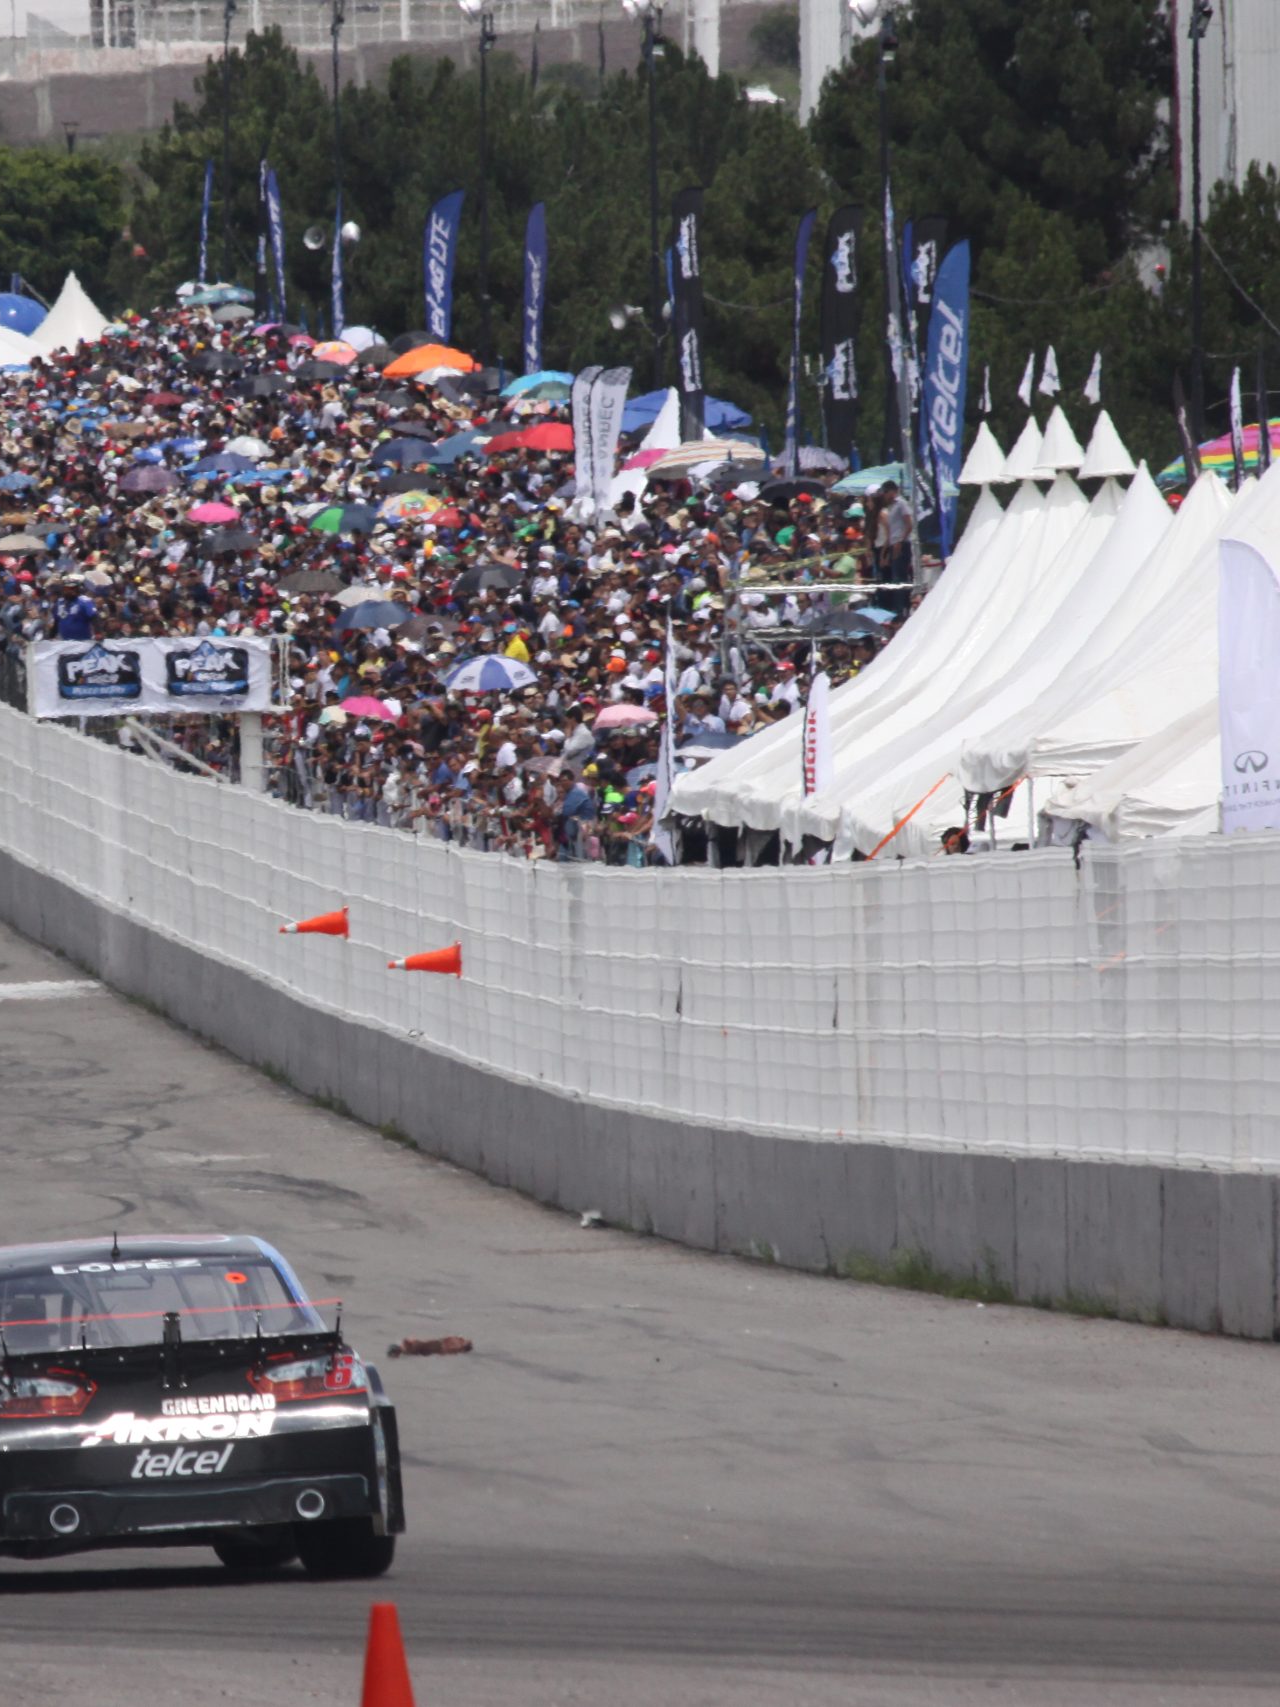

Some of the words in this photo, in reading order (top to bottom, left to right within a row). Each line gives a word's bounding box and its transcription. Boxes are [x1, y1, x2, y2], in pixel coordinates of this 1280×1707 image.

[66, 652, 133, 683] PEAK
[174, 650, 240, 679] PEAK
[323, 1354, 353, 1390] 6
[131, 1443, 234, 1478] telcel
